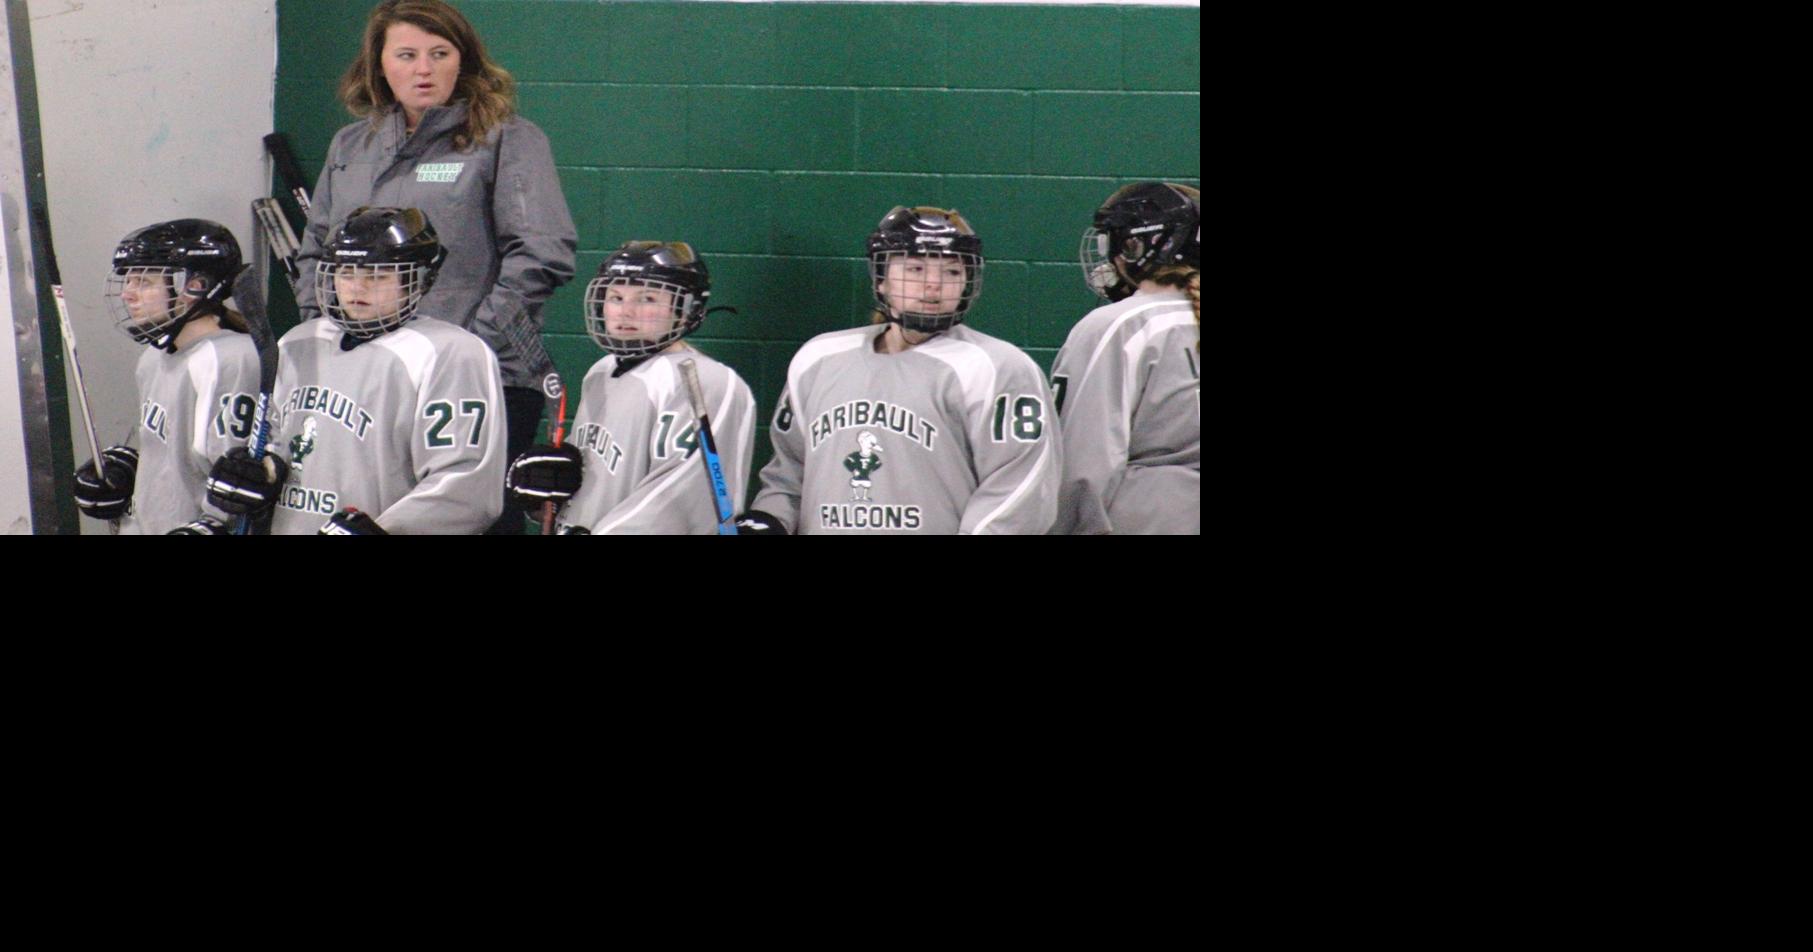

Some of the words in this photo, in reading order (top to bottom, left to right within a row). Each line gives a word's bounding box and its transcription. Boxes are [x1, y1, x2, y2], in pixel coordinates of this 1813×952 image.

[423, 398, 487, 449] 27
[655, 411, 703, 461] 14
[809, 399, 938, 452] FARIBAULT
[991, 393, 1045, 442] 18
[821, 504, 922, 529] FALCONS
